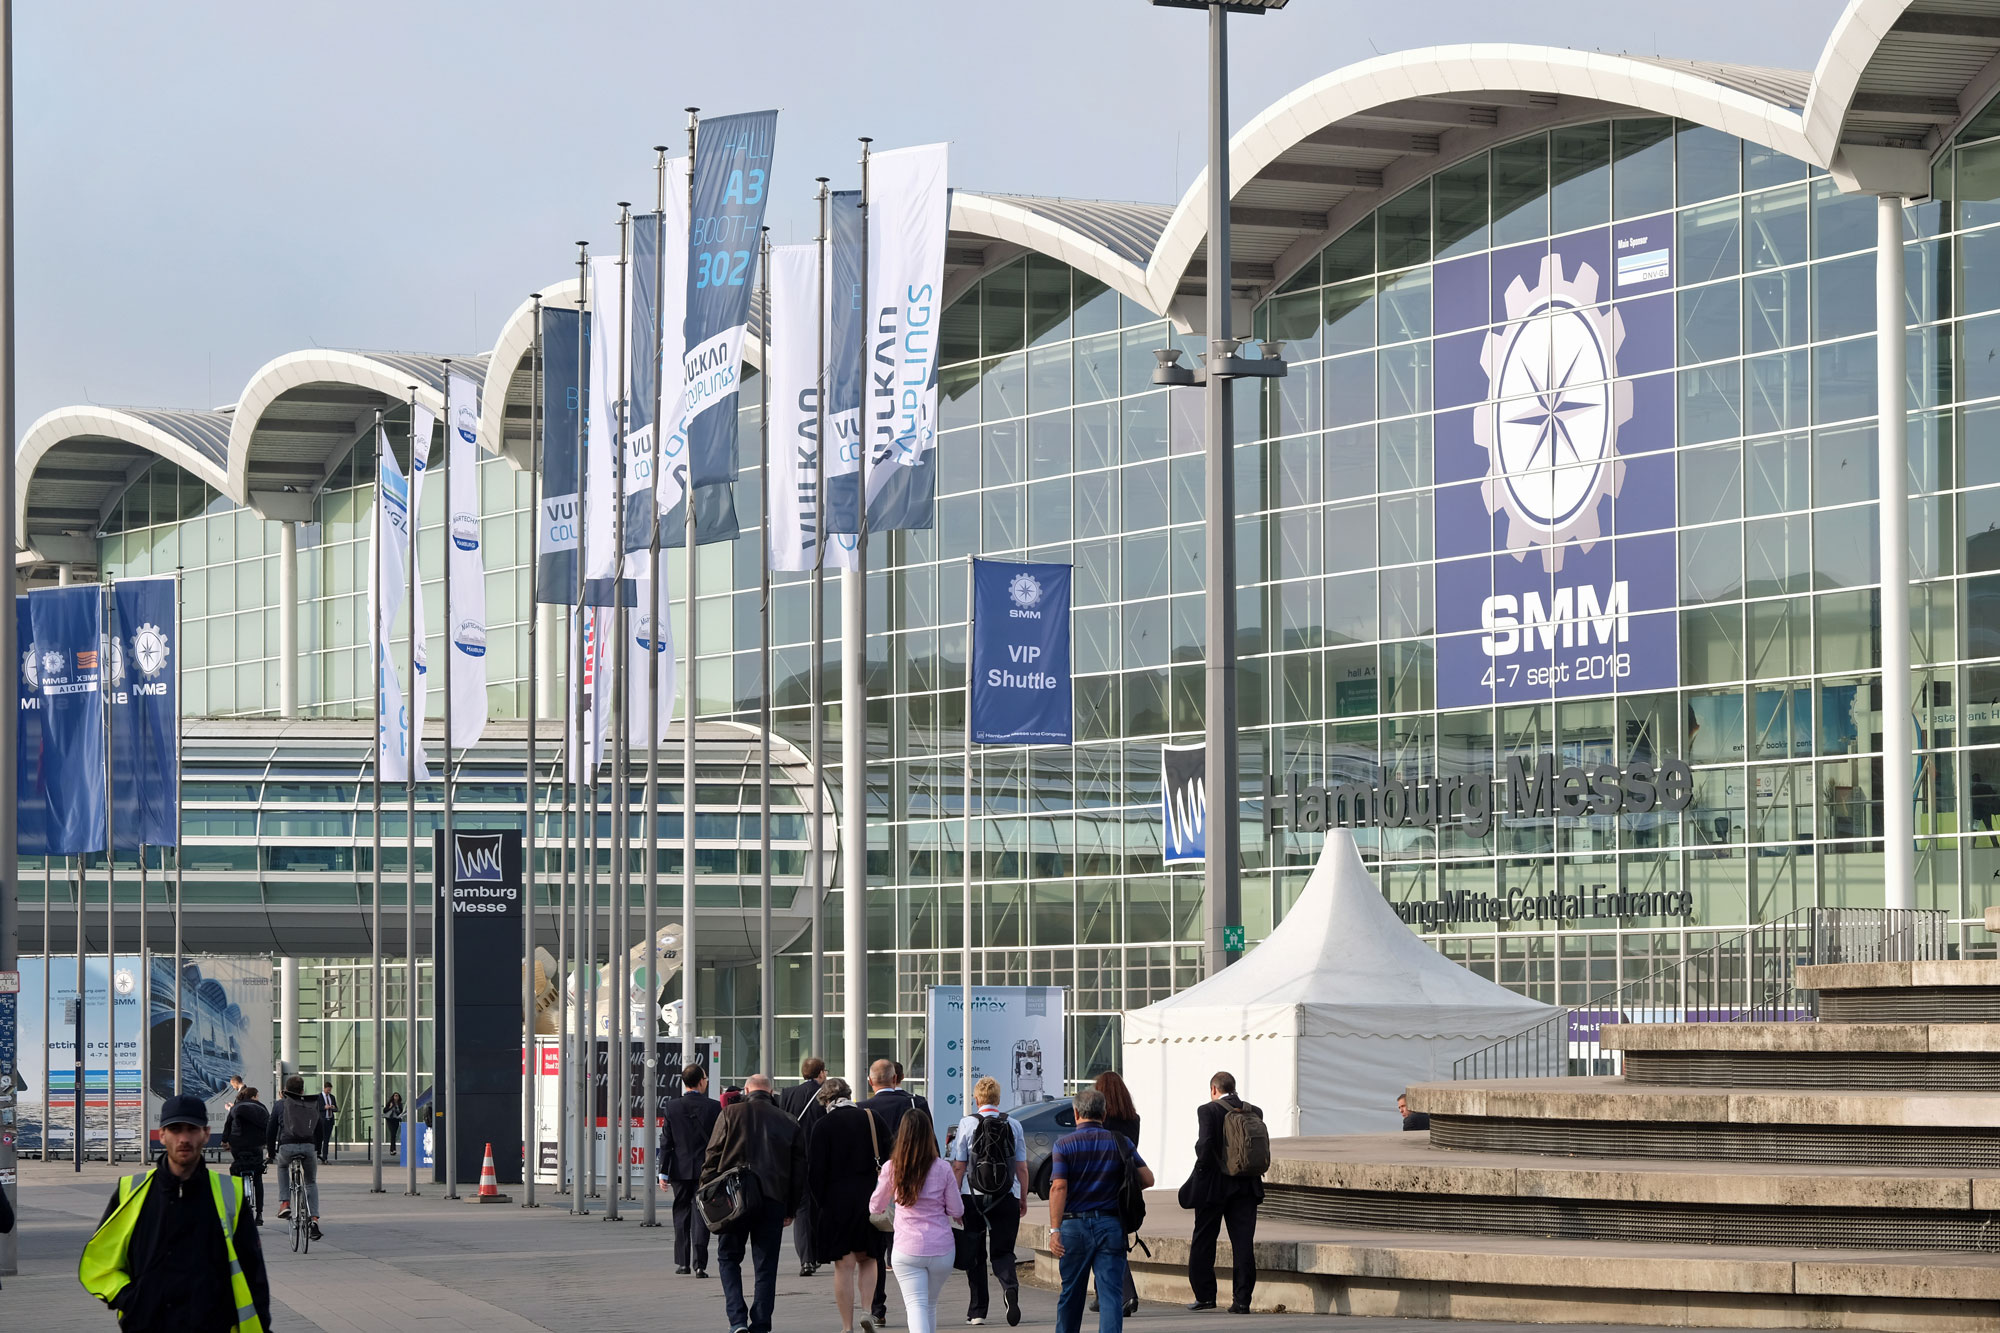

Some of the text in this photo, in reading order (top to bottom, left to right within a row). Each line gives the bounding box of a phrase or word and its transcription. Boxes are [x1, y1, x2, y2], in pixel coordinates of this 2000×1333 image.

[722, 130, 768, 160] HALL
[722, 169, 765, 205] A3
[693, 216, 759, 246] BOOTH
[1617, 236, 1648, 249] Main Sponsor
[696, 251, 750, 289] 302
[1009, 609, 1041, 619] SMM
[1481, 580, 1629, 656] SMM
[1008, 645, 1041, 663] VIP
[987, 669, 1057, 690] Shuttle
[1347, 667, 1362, 677] hall
[1480, 653, 1631, 689] 4-7 sept 2018
[1263, 753, 1694, 838] Hamburg Messe
[452, 901, 507, 913] Messe
[1444, 889, 1501, 923] Mitte
[1507, 885, 1585, 922] Central
[1592, 884, 1693, 918] Entrance
